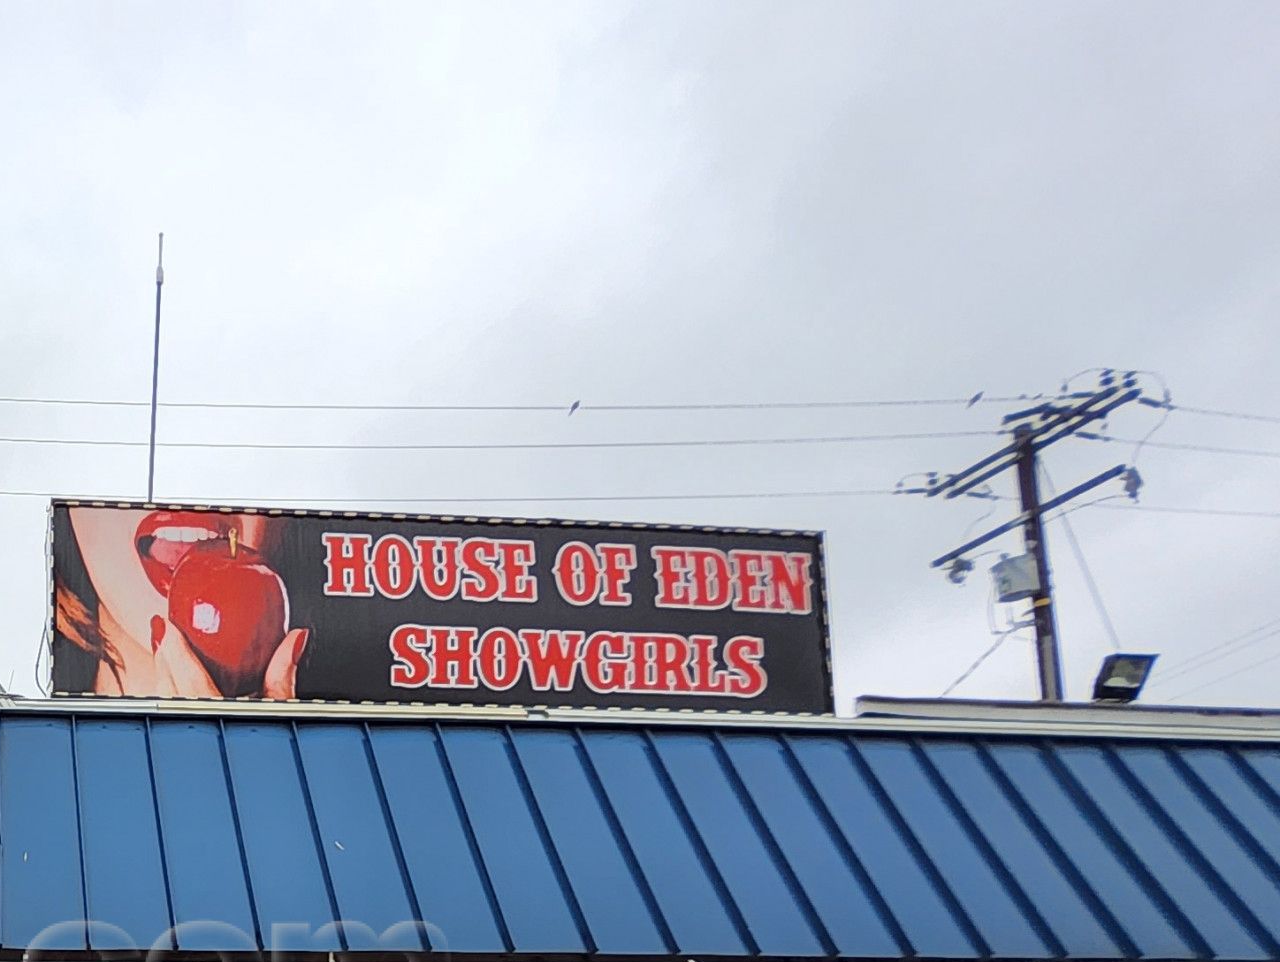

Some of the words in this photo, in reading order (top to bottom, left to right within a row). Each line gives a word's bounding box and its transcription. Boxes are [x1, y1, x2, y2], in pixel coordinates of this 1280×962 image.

[322, 532, 537, 602] HOUSE
[552, 541, 636, 606] OF
[651, 546, 814, 615] EDEN
[389, 623, 768, 698] SHOWGIRLS
